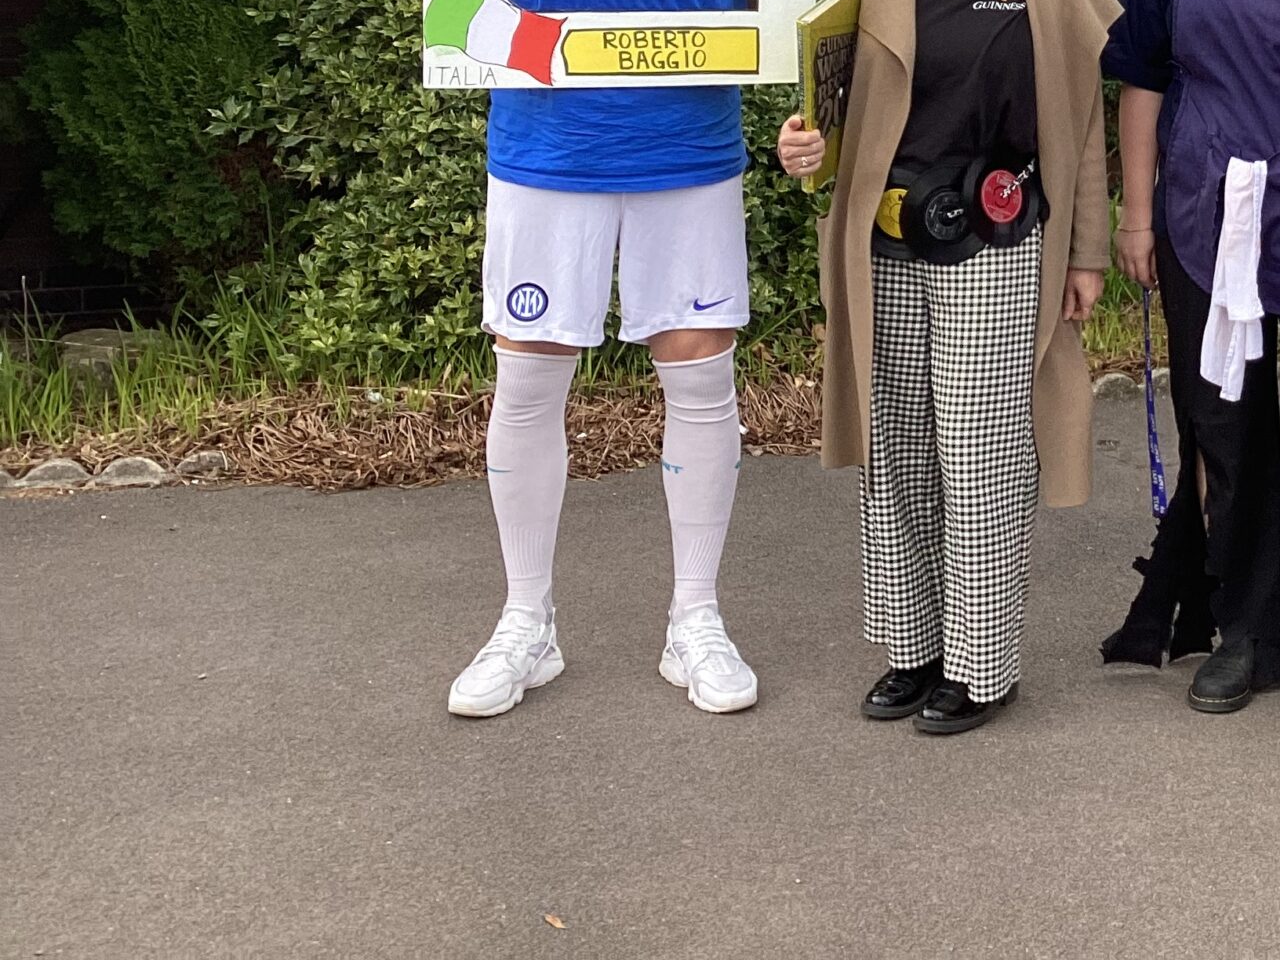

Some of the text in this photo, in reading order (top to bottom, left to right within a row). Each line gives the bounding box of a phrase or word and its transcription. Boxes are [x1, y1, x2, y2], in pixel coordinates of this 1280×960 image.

[972, 0, 1027, 10] GUINNESS
[603, 30, 707, 50] ROBERTO
[618, 50, 707, 70] BAGGIO
[427, 66, 498, 87] ITALIA
